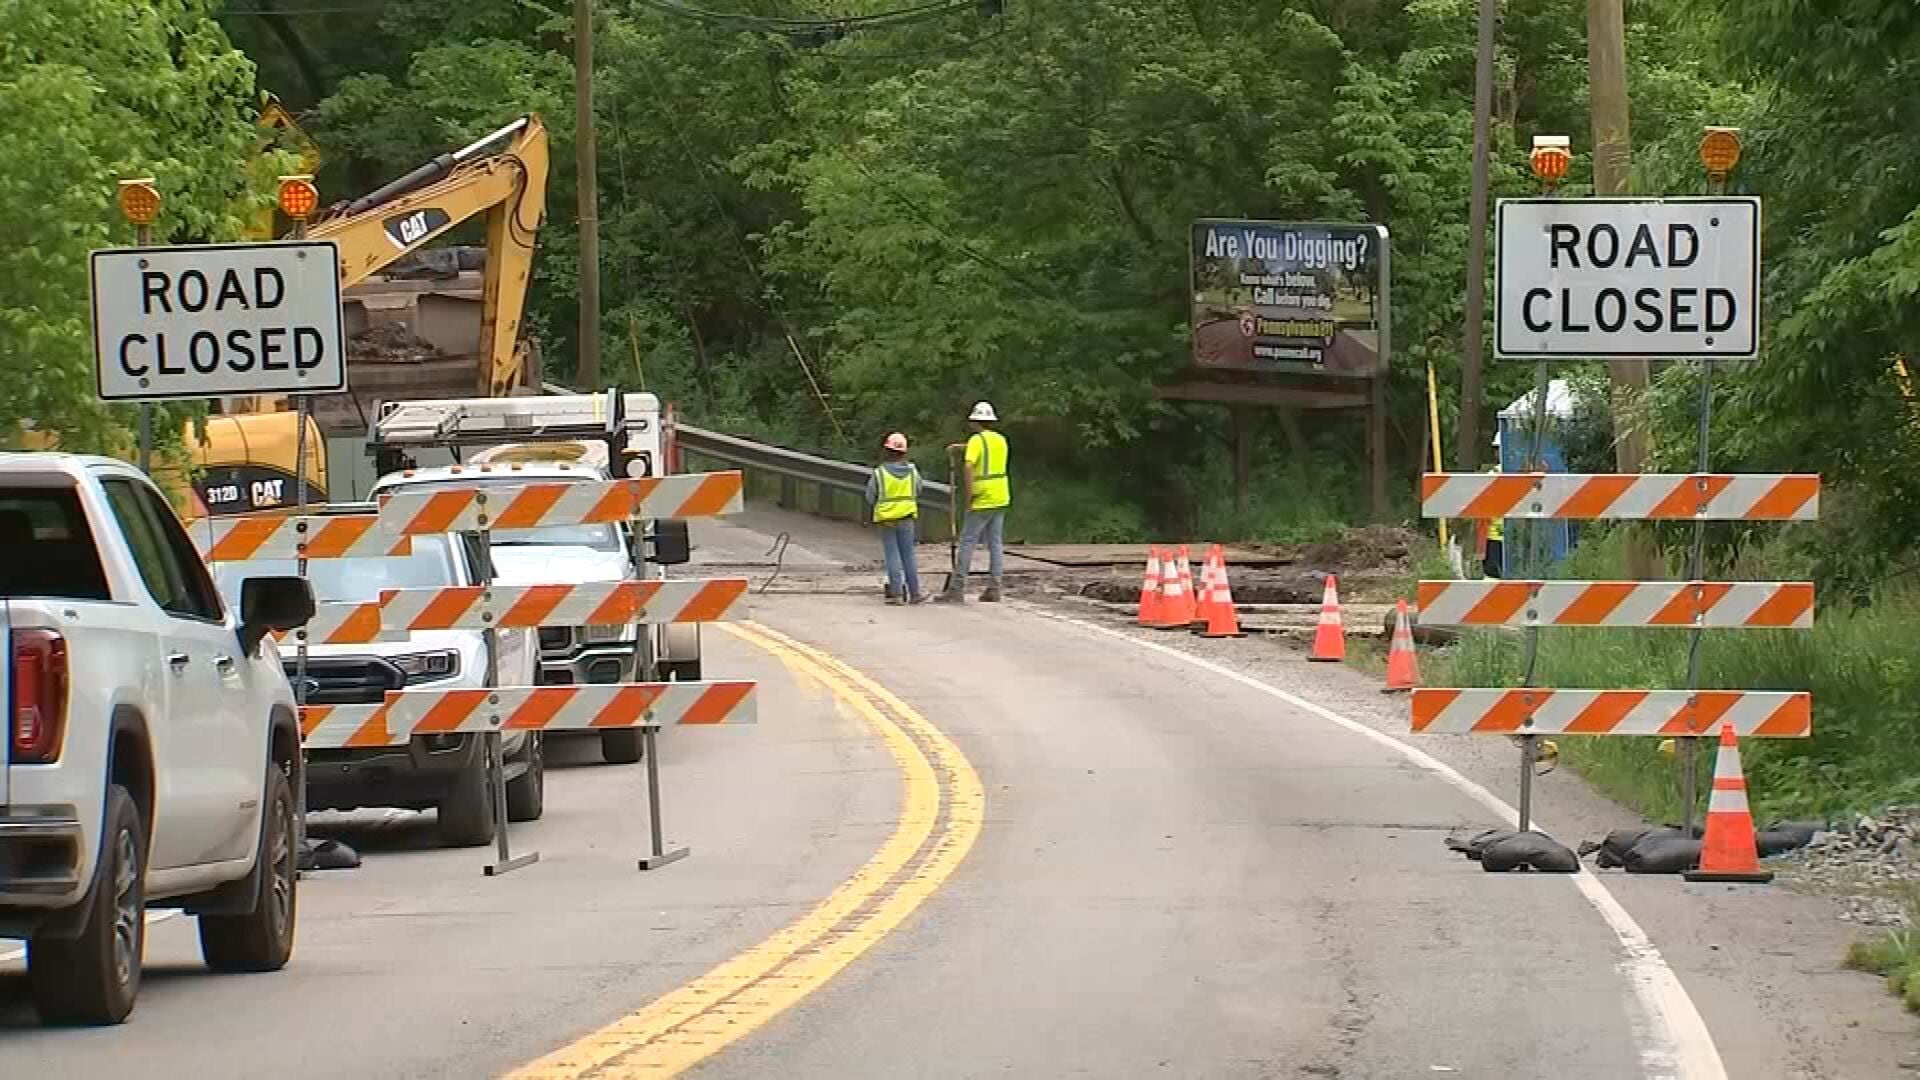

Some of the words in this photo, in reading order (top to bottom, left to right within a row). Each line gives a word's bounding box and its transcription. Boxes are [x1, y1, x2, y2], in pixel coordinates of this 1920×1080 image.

[400, 211, 428, 242] CAT
[1550, 223, 1699, 268] ROAD
[1205, 228, 1238, 257] Are
[1244, 229, 1277, 259] You
[1284, 231, 1368, 270] Digging?
[142, 267, 285, 314] ROAD
[1523, 288, 1736, 333] CLOSED
[120, 327, 323, 376] CLOSED
[207, 486, 238, 503] 312D
[252, 480, 284, 506] CAT
